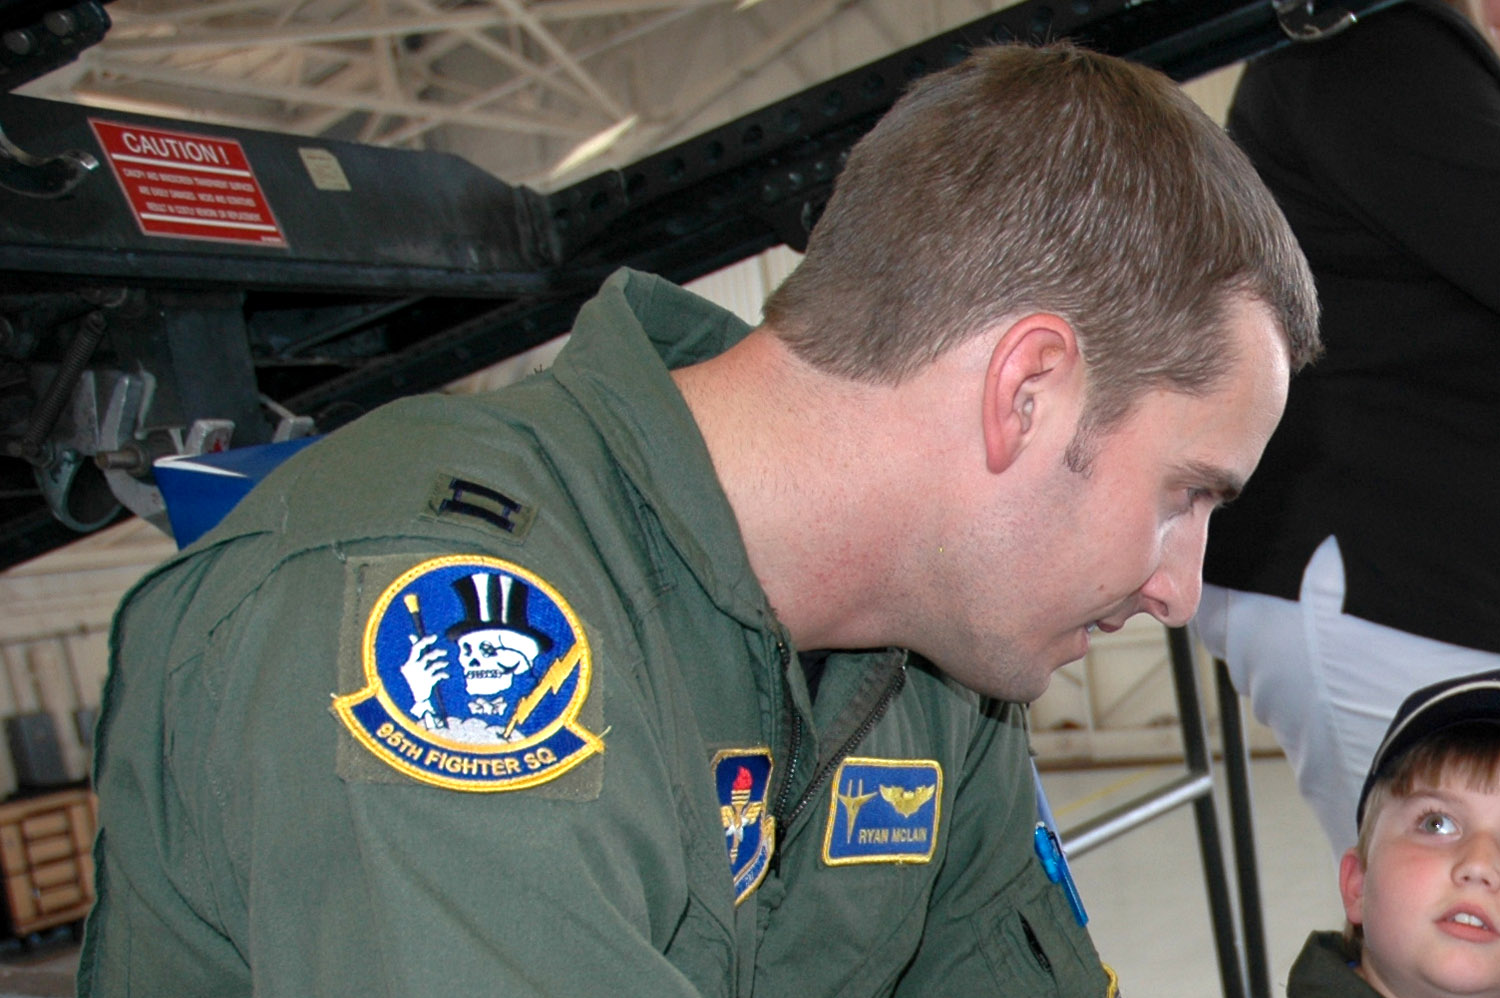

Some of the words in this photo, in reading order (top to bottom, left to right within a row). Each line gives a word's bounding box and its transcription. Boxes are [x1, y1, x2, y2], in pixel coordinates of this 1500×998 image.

[424, 748, 521, 776] FIGHTER
[523, 747, 557, 770] SQ
[859, 828, 889, 844] RYAN
